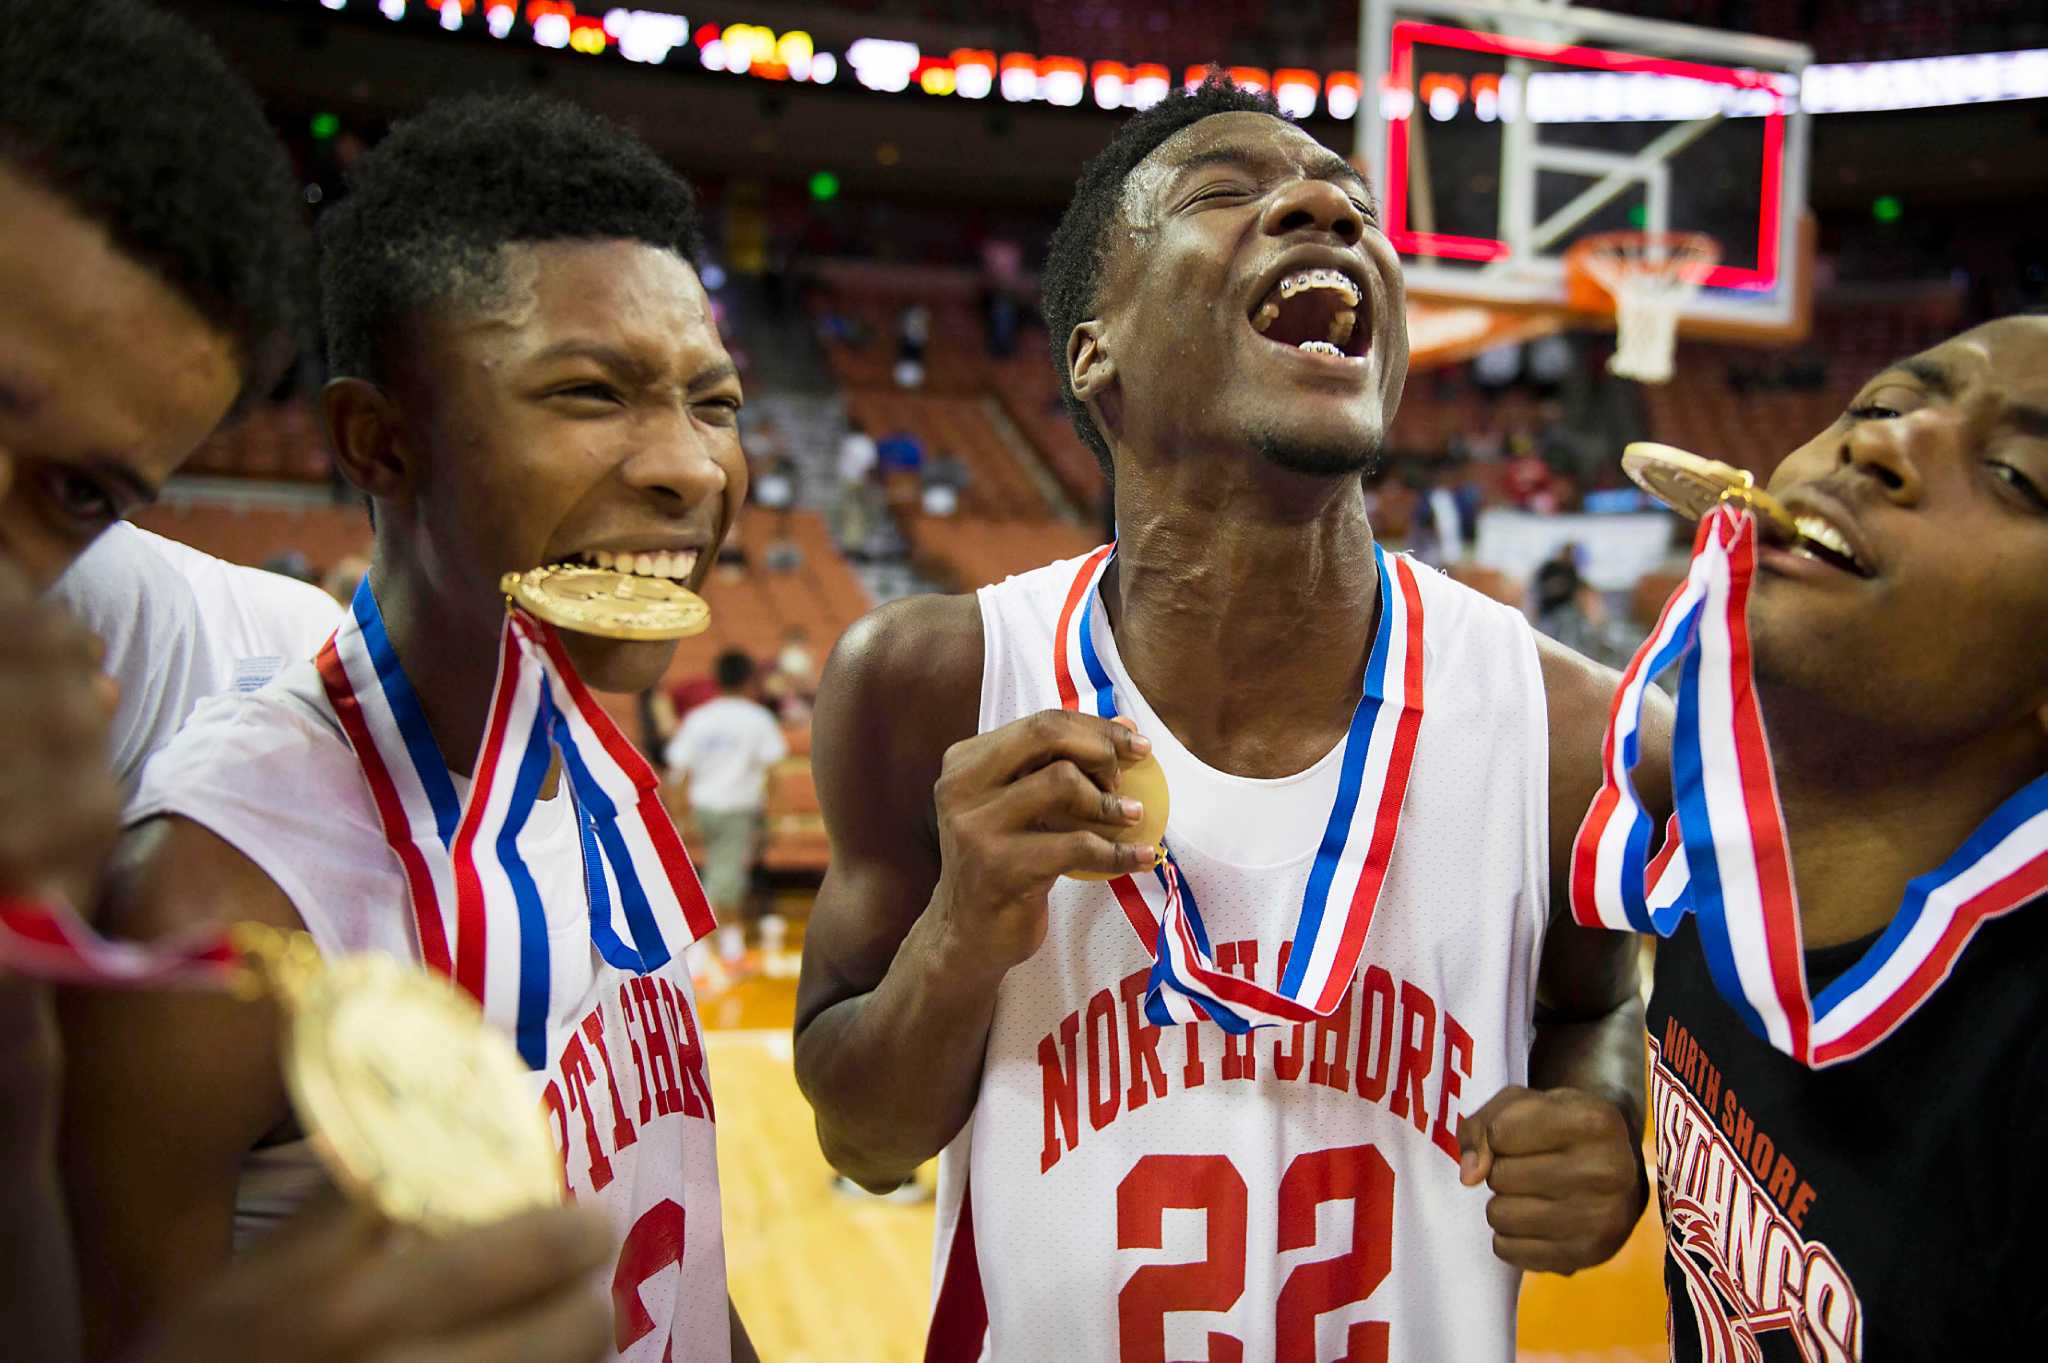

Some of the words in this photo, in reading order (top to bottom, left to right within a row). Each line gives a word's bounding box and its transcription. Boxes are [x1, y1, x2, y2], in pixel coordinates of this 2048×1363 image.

[1648, 1034, 1863, 1363] USTANGS
[1663, 1015, 1721, 1115] NORTH
[1721, 1089, 1817, 1228] SHORE
[1116, 1144, 1395, 1363] 22
